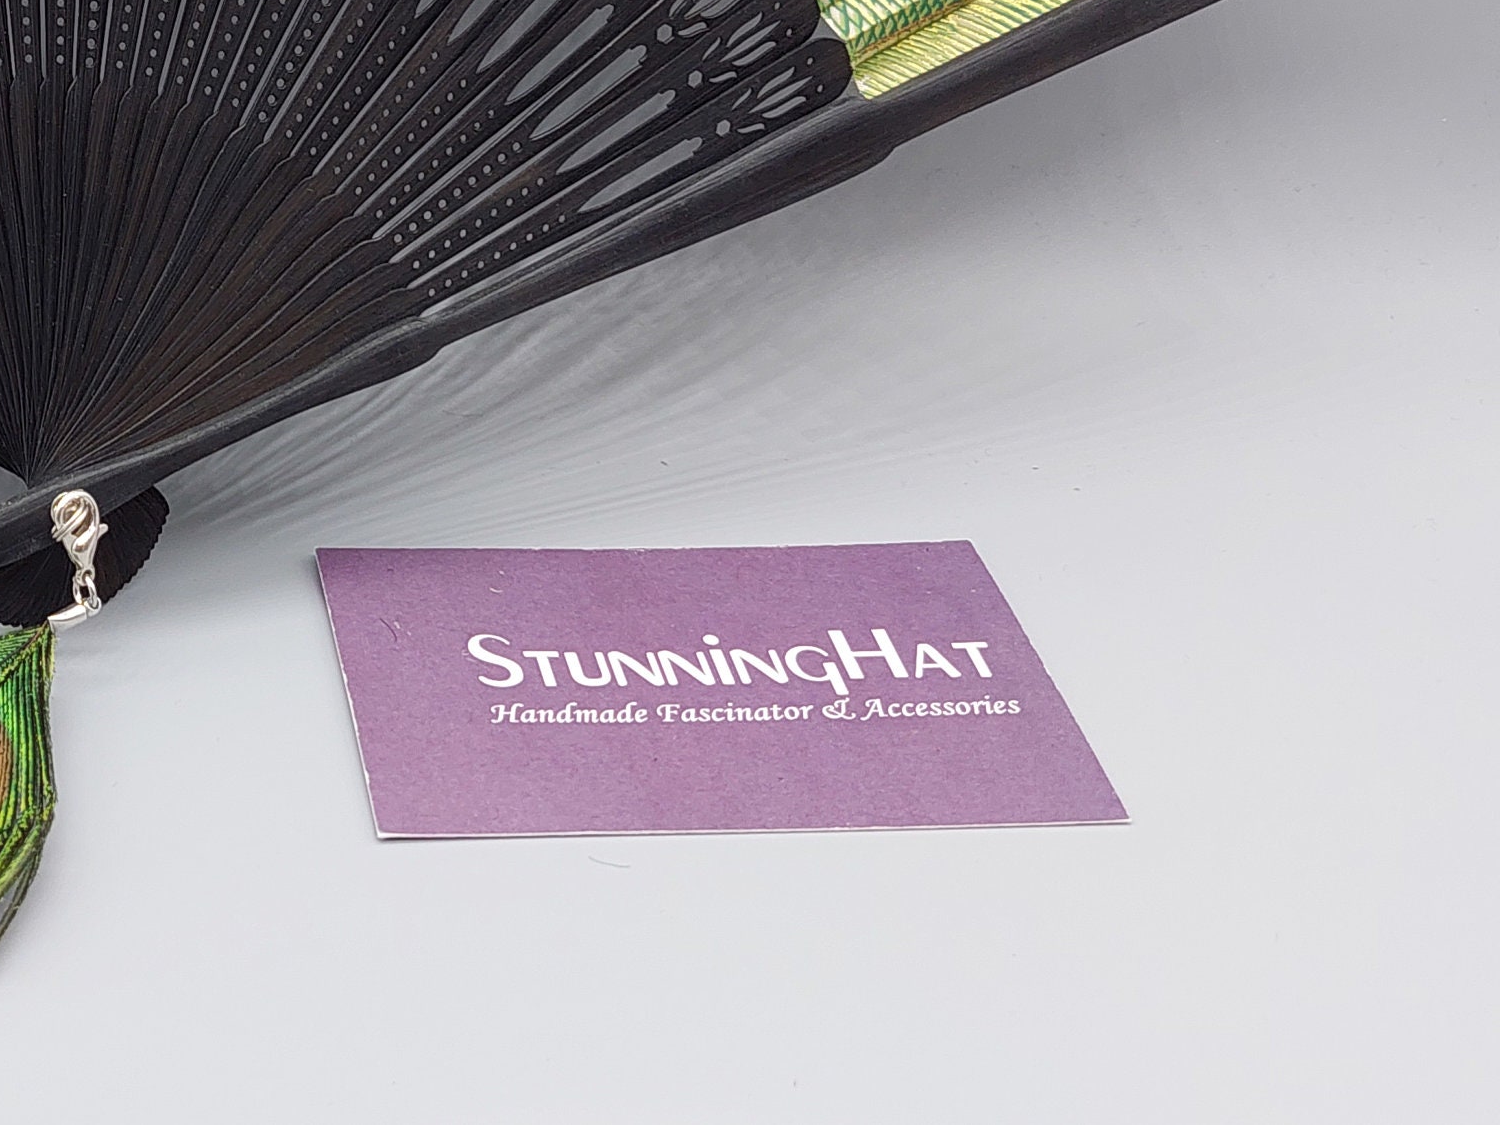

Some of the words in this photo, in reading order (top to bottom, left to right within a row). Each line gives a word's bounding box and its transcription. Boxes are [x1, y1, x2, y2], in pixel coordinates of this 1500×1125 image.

[490, 701, 649, 724] Handmade
[656, 701, 813, 723] Fascinator
[821, 696, 857, 720] &
[859, 695, 1022, 722] Accessories
